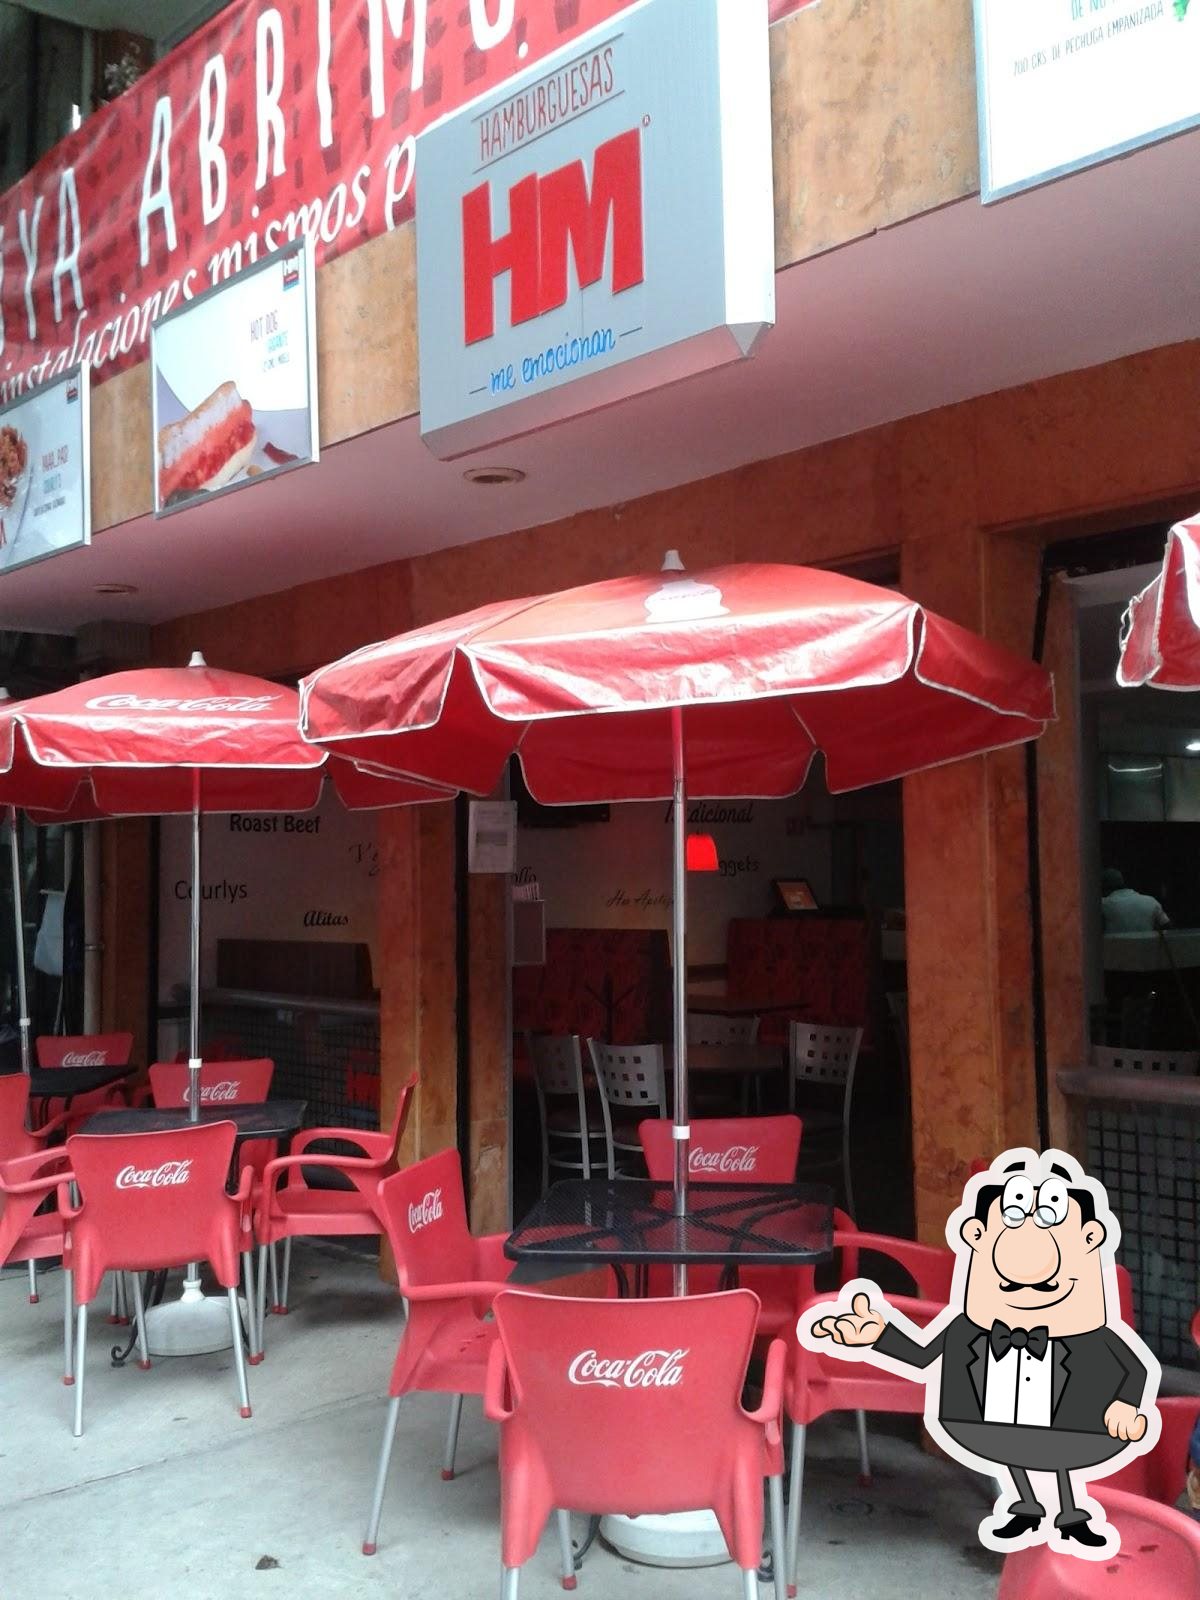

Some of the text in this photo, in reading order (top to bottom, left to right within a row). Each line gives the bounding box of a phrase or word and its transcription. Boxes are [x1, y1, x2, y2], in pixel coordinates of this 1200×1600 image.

[1065, 26, 1104, 56] PECHUGA
[1107, 1, 1164, 39] EMPANIZADA
[479, 47, 613, 161] HAMBURGUESAS
[462, 126, 645, 347] HM
[489, 327, 616, 395] me emocionan
[85, 694, 284, 711] Coca-Cola
[229, 813, 321, 834] Roast Beef
[303, 910, 349, 927] Alitas
[116, 1159, 193, 1189] Coca-Cola
[688, 1146, 760, 1173] Coca-Cola
[408, 1187, 443, 1234] Coca-Cola
[568, 1348, 690, 1388] Coca-Cola
